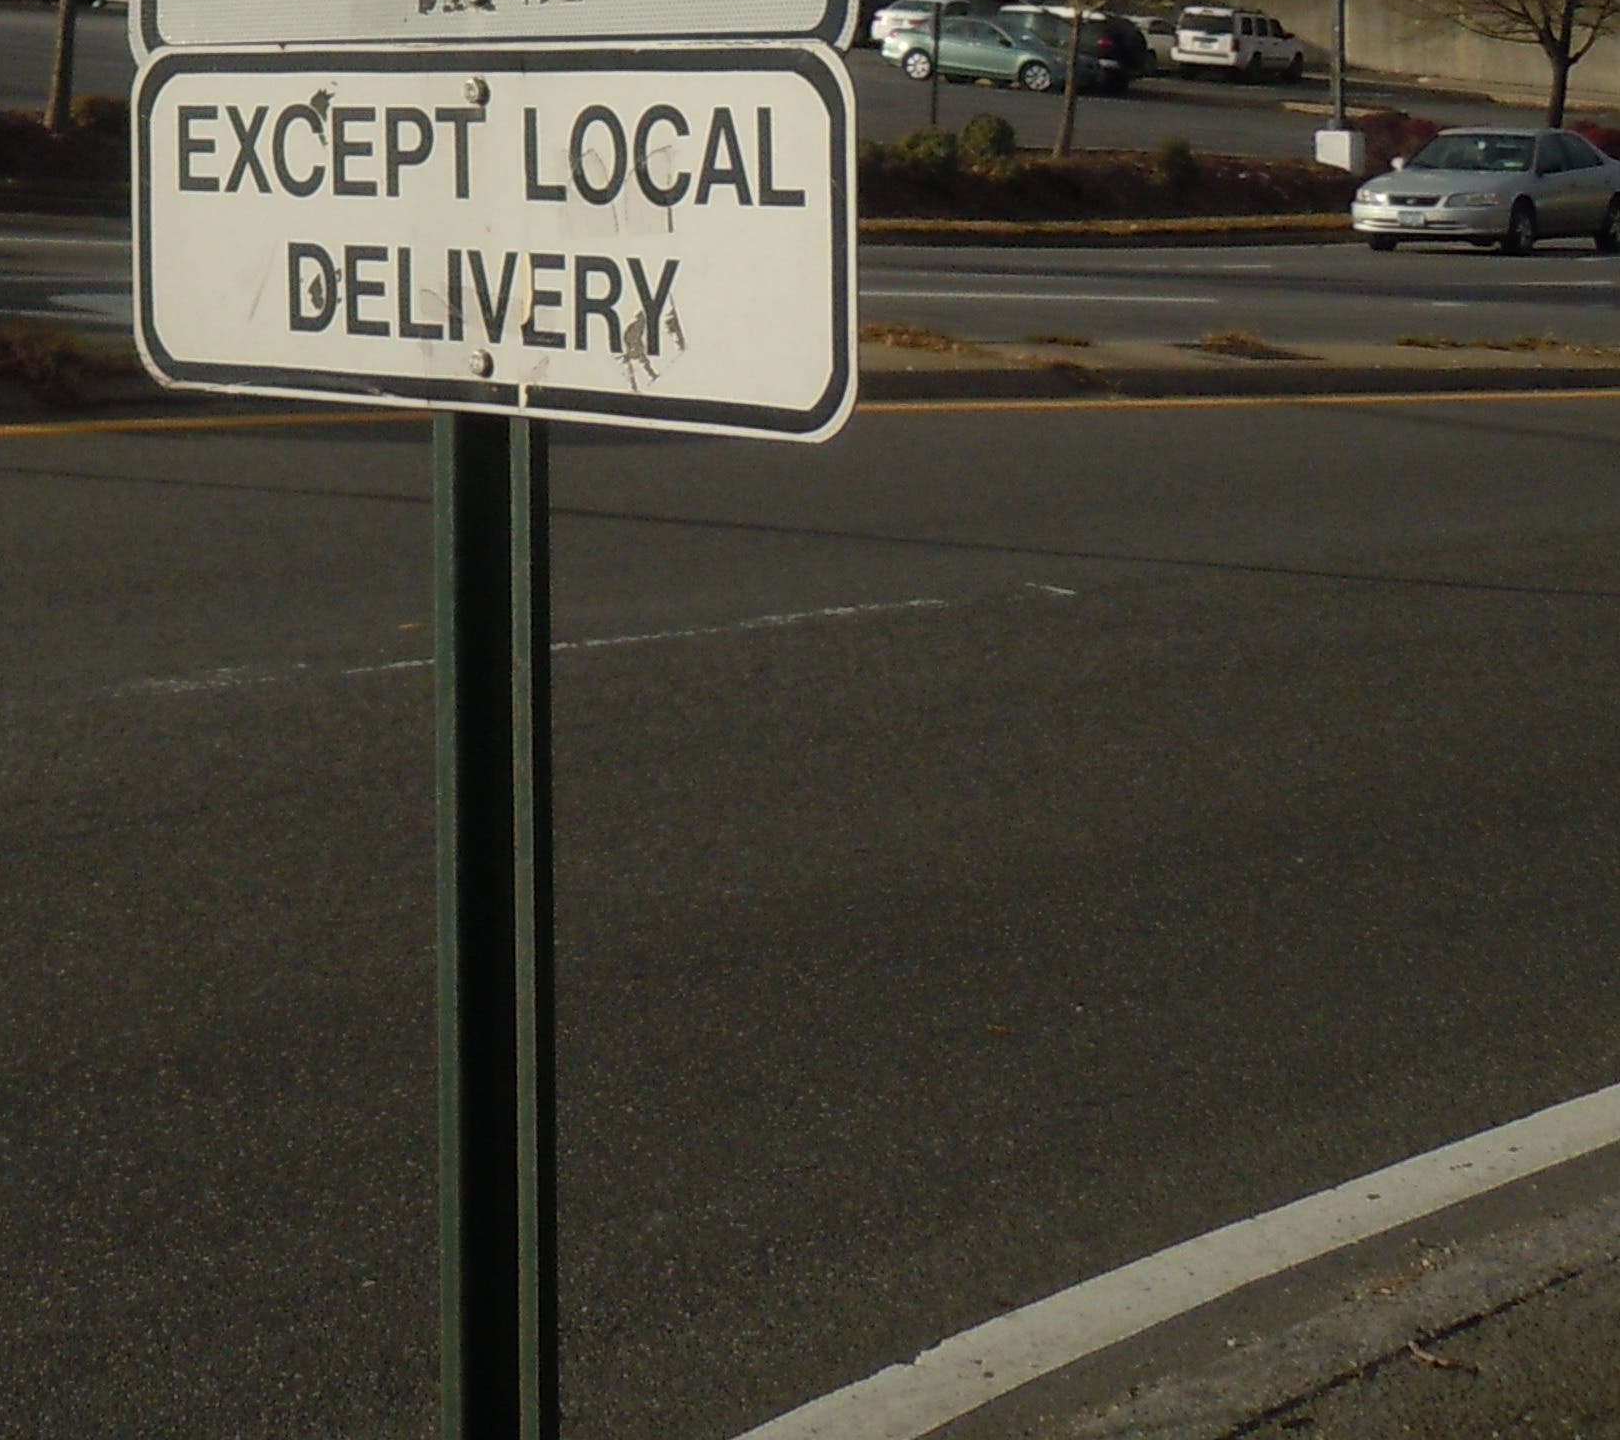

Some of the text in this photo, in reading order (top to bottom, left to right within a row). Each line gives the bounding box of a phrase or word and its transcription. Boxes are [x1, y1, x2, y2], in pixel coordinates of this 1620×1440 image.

[178, 104, 805, 207] EXCEPT LOCAL
[288, 242, 679, 357] DELIVERY
